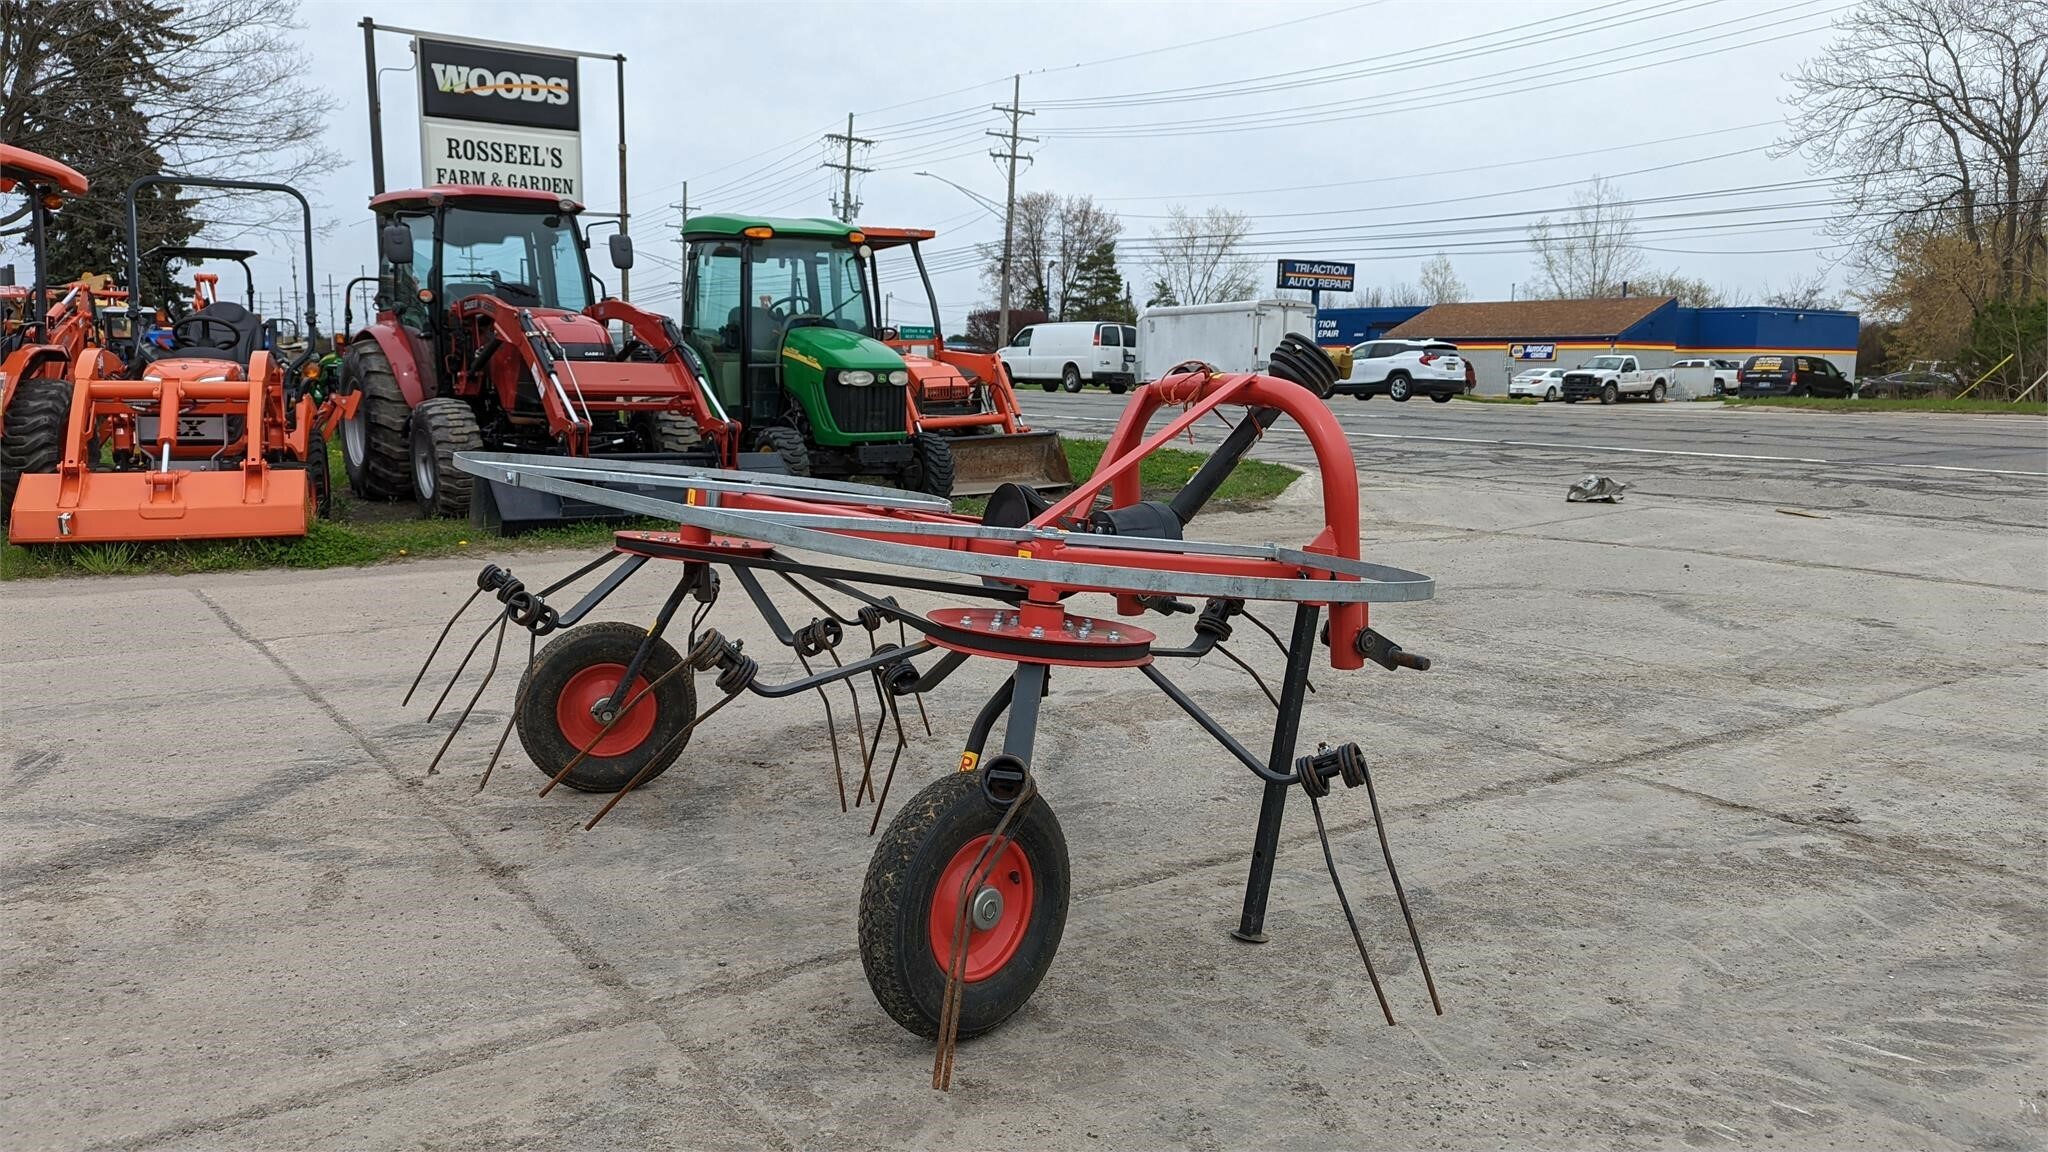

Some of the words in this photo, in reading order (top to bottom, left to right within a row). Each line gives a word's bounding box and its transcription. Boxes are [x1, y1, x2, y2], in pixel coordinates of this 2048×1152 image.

[431, 62, 570, 106] WOODS
[446, 137, 563, 169] ROSSEEL'S
[436, 168, 486, 186] FARM
[491, 172, 503, 187] &
[507, 173, 574, 195] GARDEN
[1288, 277, 1315, 287] AUTO
[1318, 279, 1351, 288] REPAIR
[1317, 329, 1339, 337] EPAIR
[1318, 320, 1337, 329] TION
